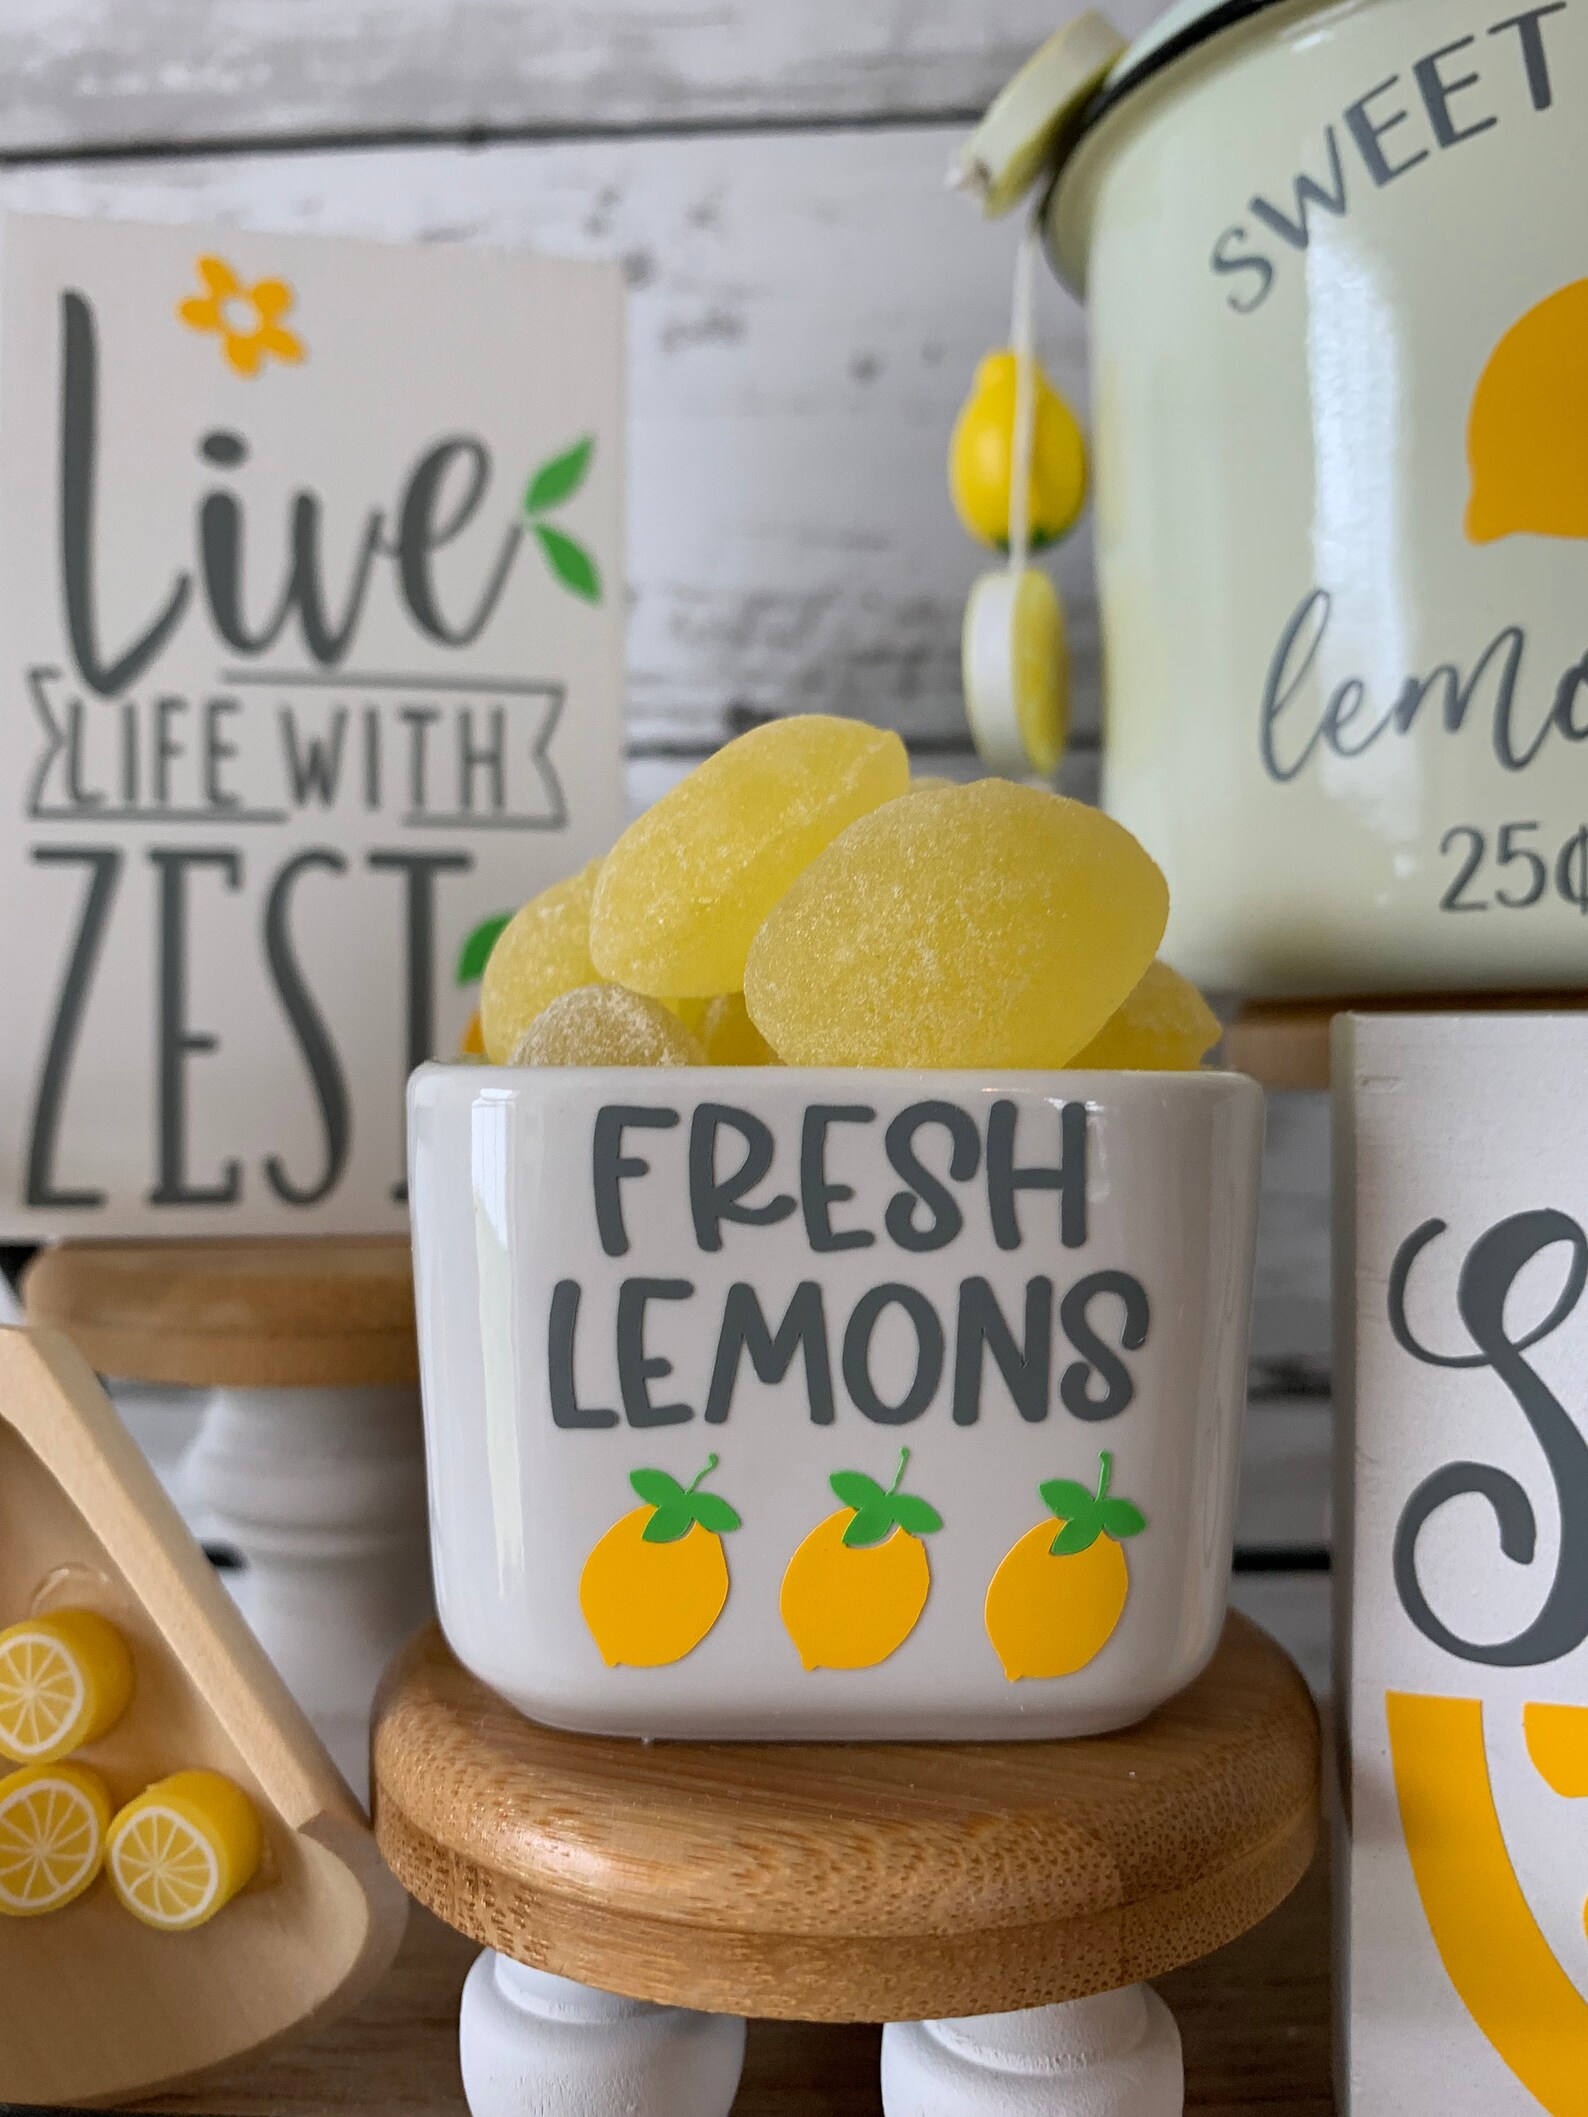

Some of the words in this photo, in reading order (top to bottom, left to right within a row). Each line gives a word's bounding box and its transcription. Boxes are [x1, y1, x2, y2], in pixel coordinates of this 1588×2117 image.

[1209, 2, 1568, 314] SWEET
[58, 288, 526, 697] Live
[62, 694, 246, 814] LIFE
[280, 702, 508, 816] WITH
[22, 846, 476, 1207] ZEST
[592, 1099, 1089, 1256] FRESH
[548, 1270, 1150, 1430] LEMONS
